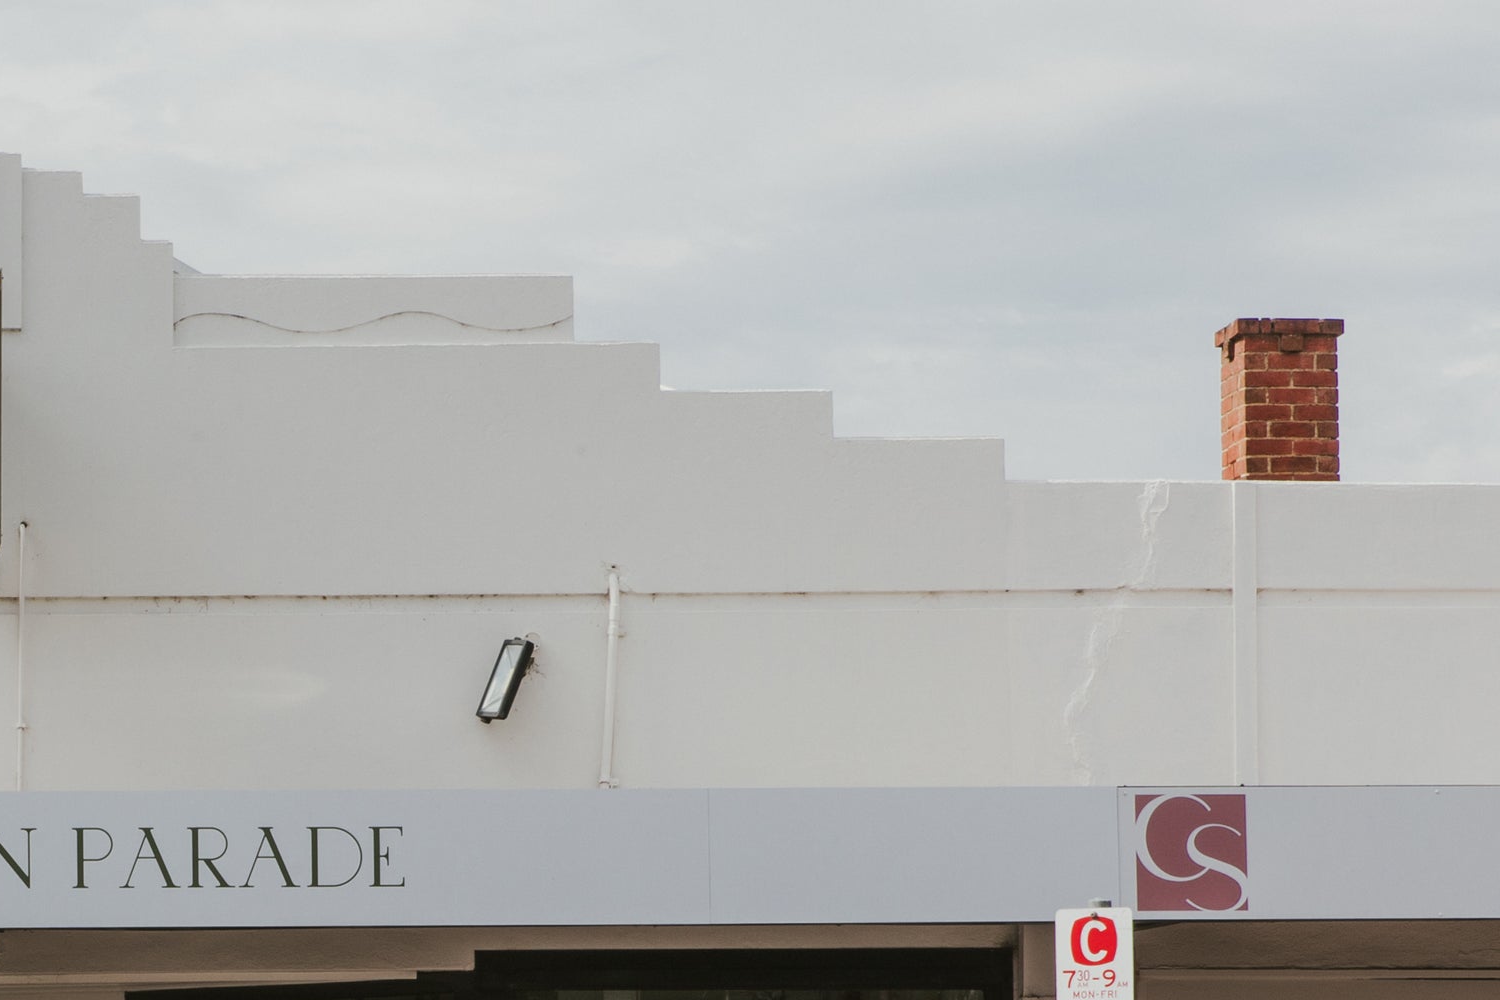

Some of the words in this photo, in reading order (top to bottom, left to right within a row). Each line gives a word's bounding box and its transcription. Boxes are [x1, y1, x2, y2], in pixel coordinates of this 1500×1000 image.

[71, 825, 406, 889] PARADE
[1135, 793, 1248, 911] CS
[1079, 919, 1109, 963] C
[1072, 990, 1118, 999] MON-FRI
